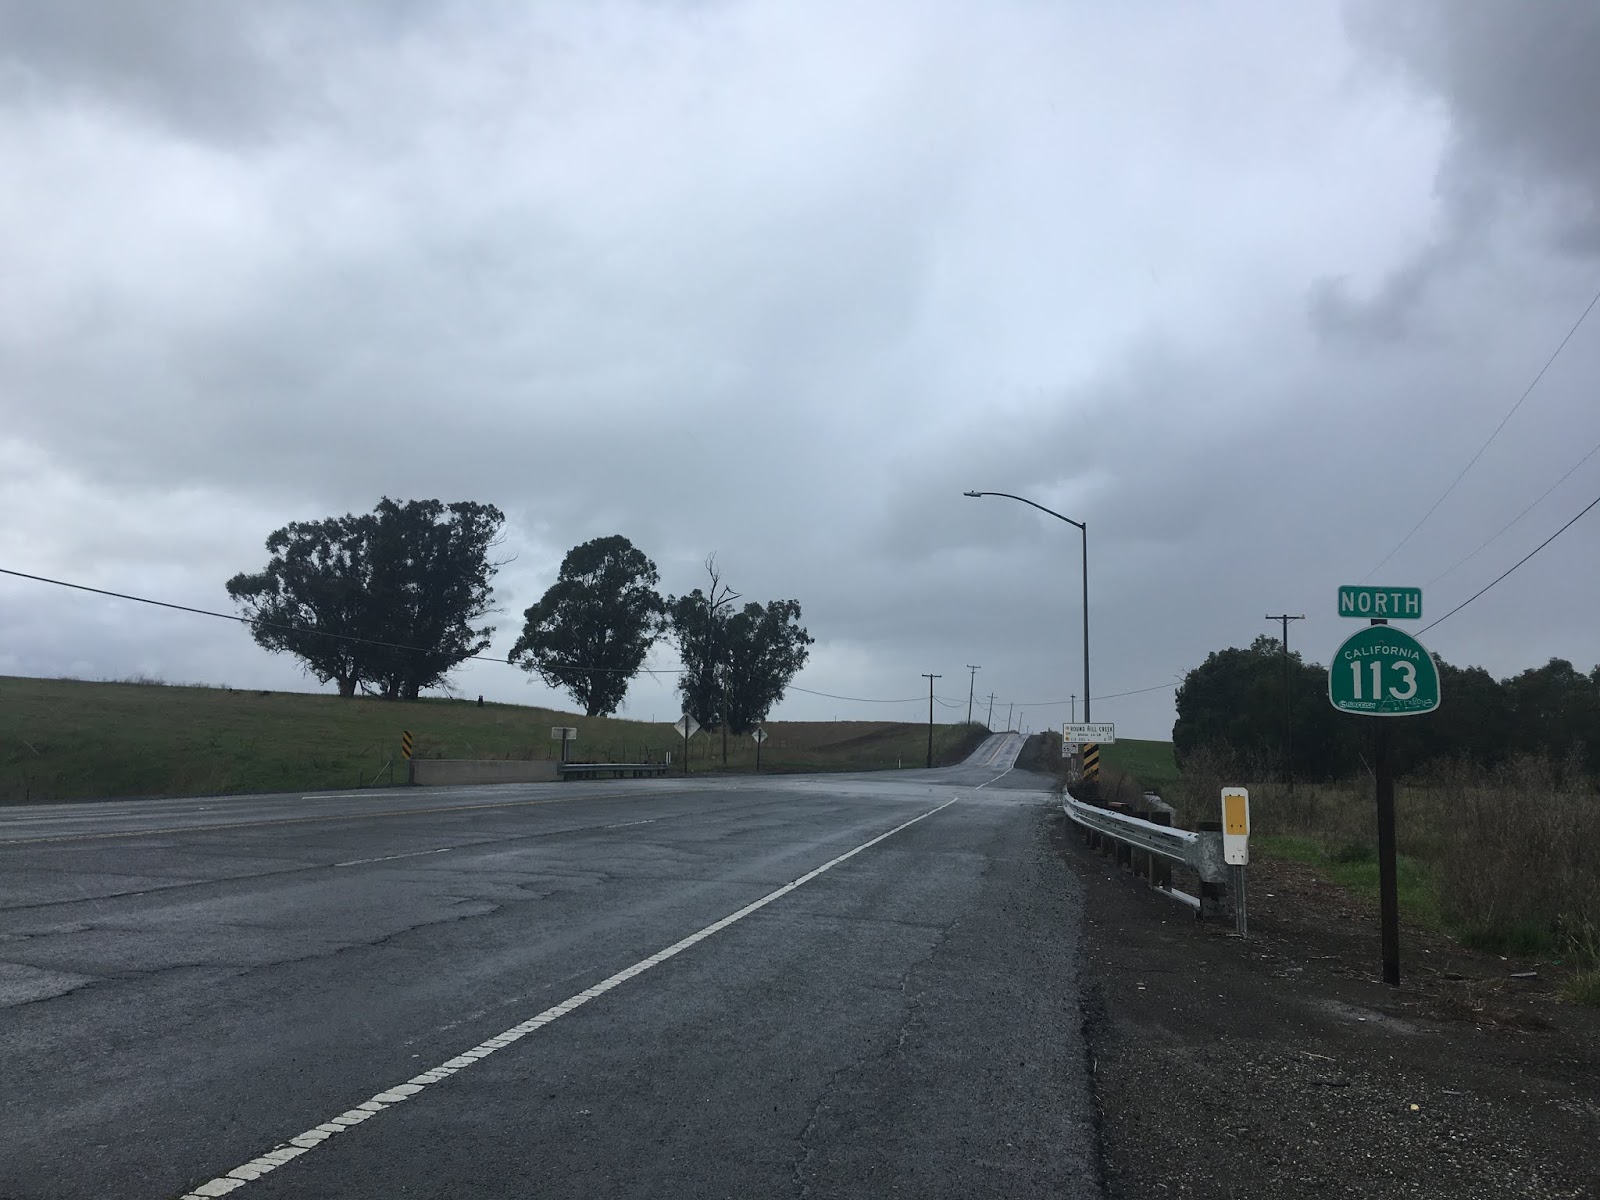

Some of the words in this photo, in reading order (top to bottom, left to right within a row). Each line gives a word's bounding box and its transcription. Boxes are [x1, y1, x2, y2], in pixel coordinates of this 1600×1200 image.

[1341, 592, 1419, 614] NORTH
[1344, 645, 1420, 661] CALIFORNIA
[1350, 660, 1418, 700] 113
